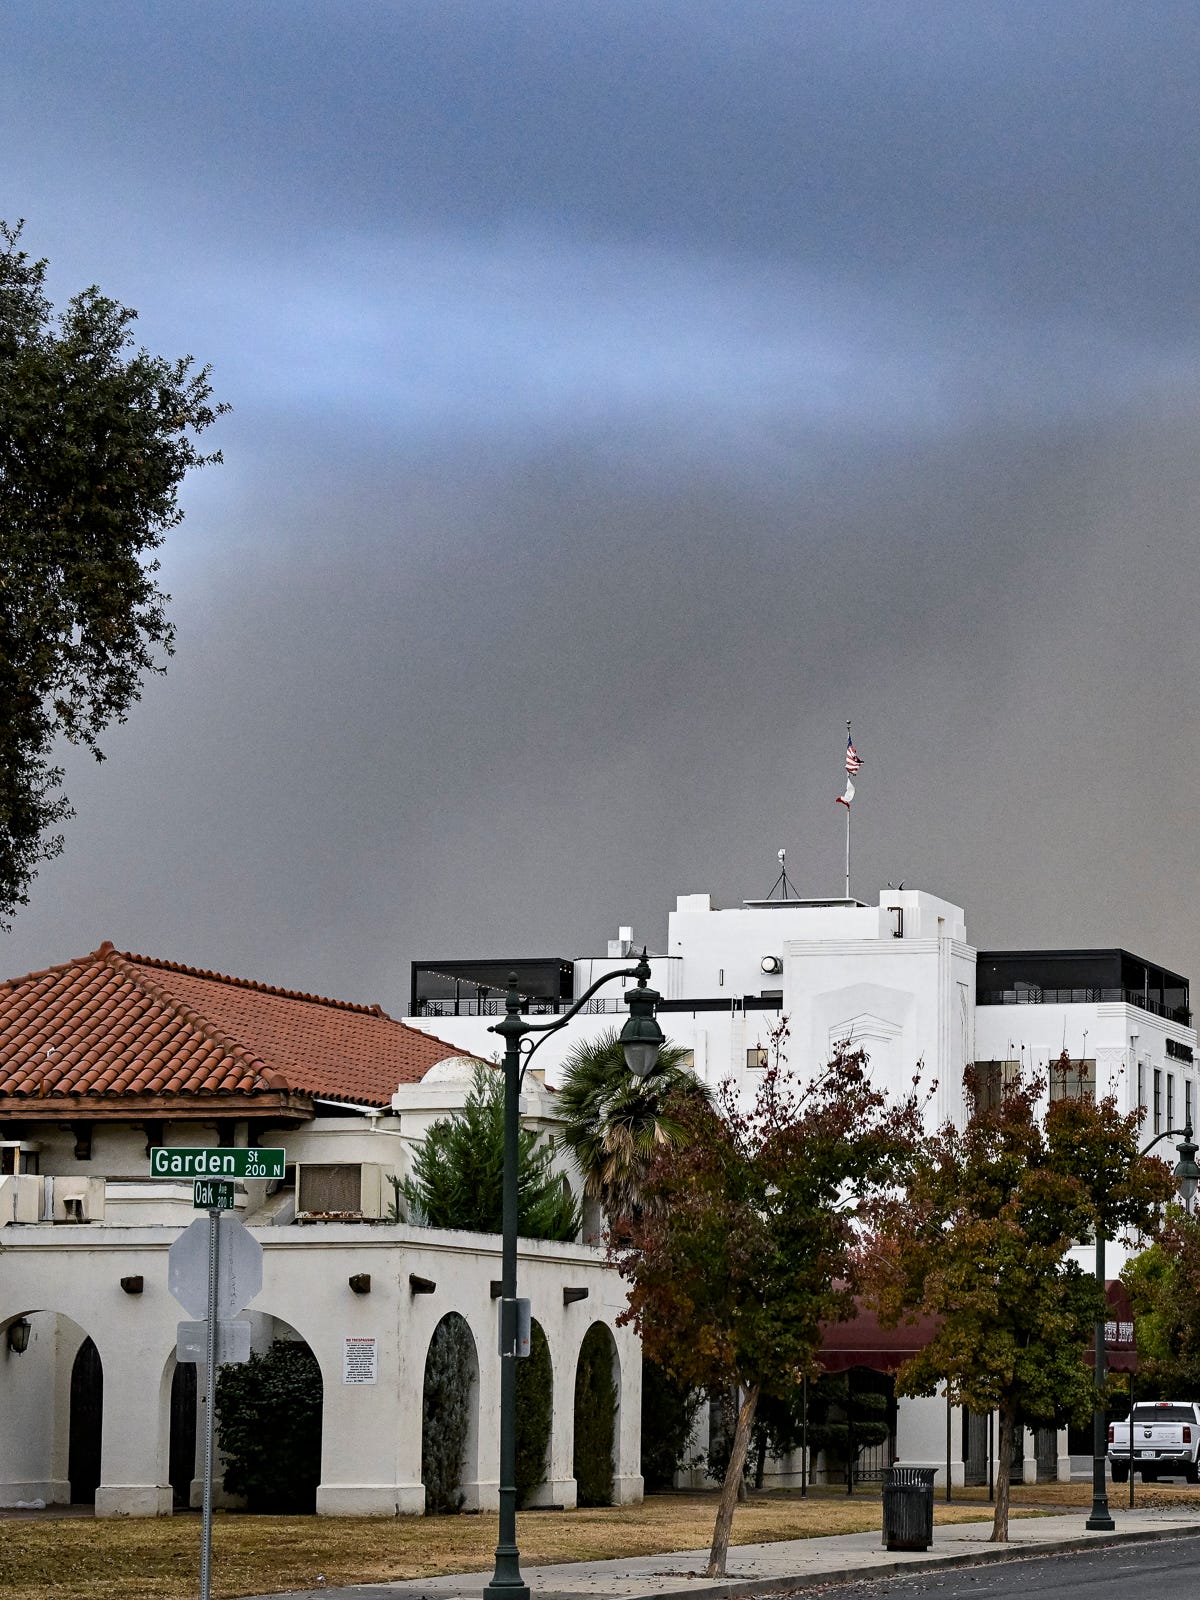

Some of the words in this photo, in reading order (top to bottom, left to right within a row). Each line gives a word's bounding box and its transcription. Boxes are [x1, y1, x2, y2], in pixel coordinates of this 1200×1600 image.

[155, 1149, 235, 1172] Garden
[247, 1151, 259, 1162] St
[245, 1164, 266, 1176] 200
[273, 1164, 280, 1176] N
[195, 1181, 214, 1204] Oak
[217, 1196, 227, 1208] 200
[229, 1196, 233, 1208] E
